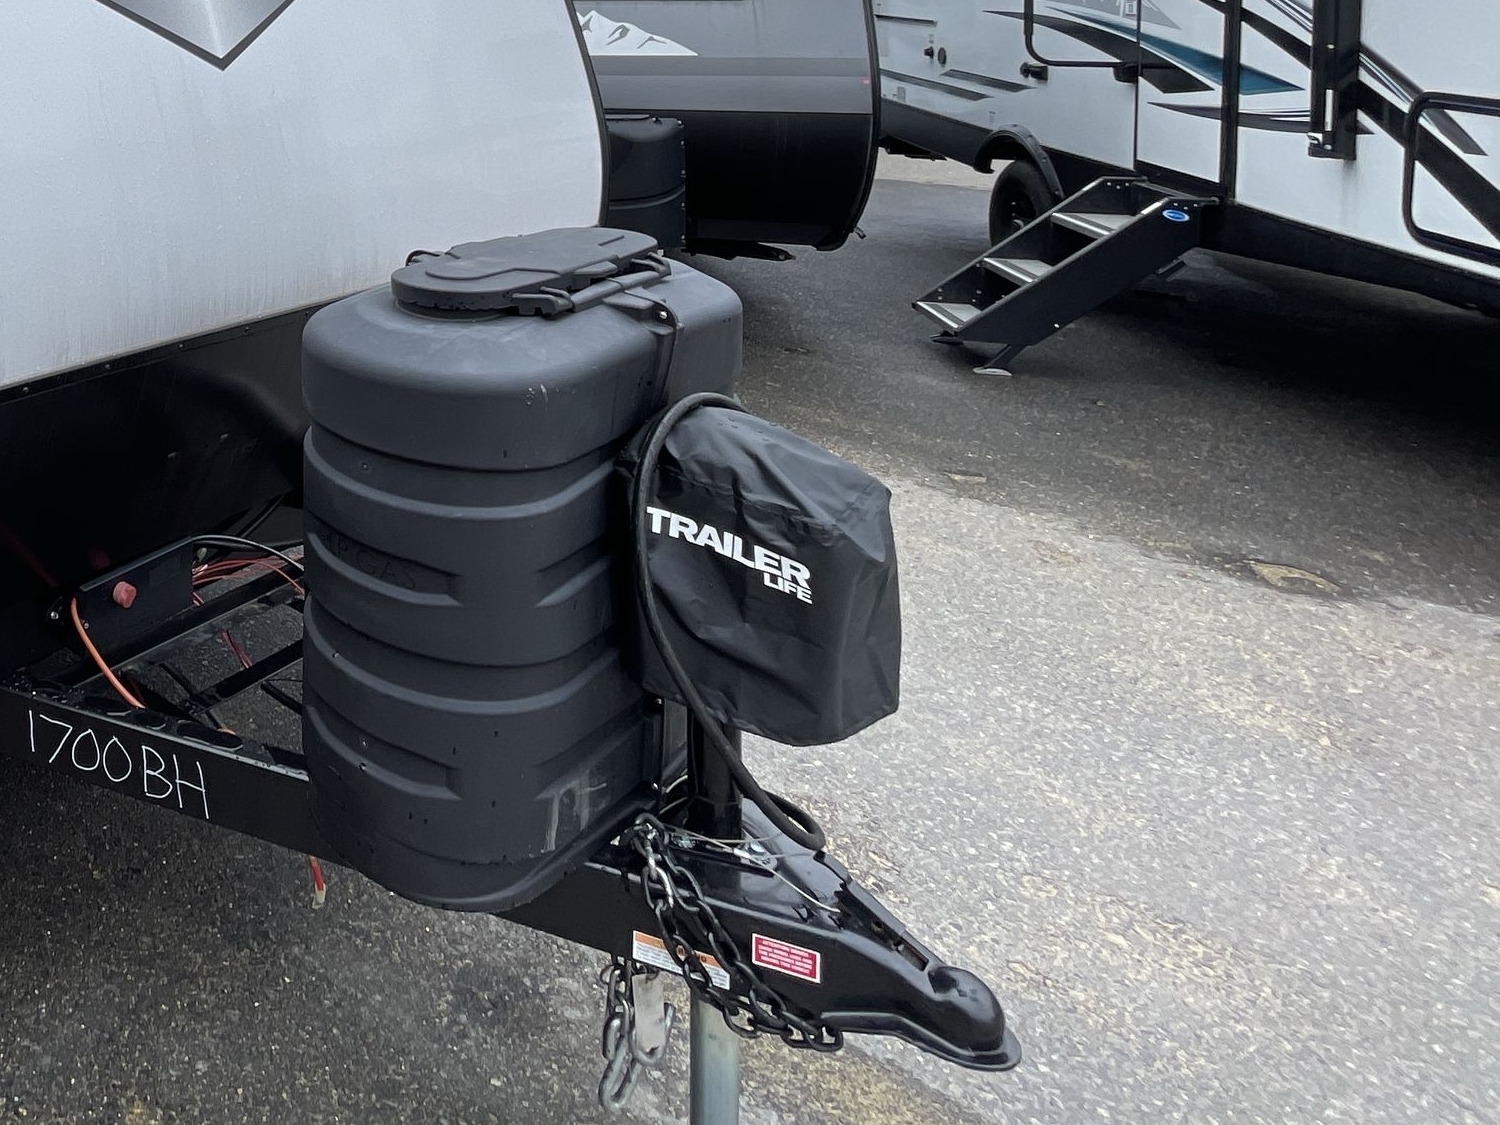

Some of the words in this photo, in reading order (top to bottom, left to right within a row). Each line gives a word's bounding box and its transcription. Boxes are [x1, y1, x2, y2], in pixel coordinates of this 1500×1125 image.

[646, 505, 812, 589] TRAILER
[763, 571, 813, 605] LIFE
[27, 709, 210, 820] 1700BH
